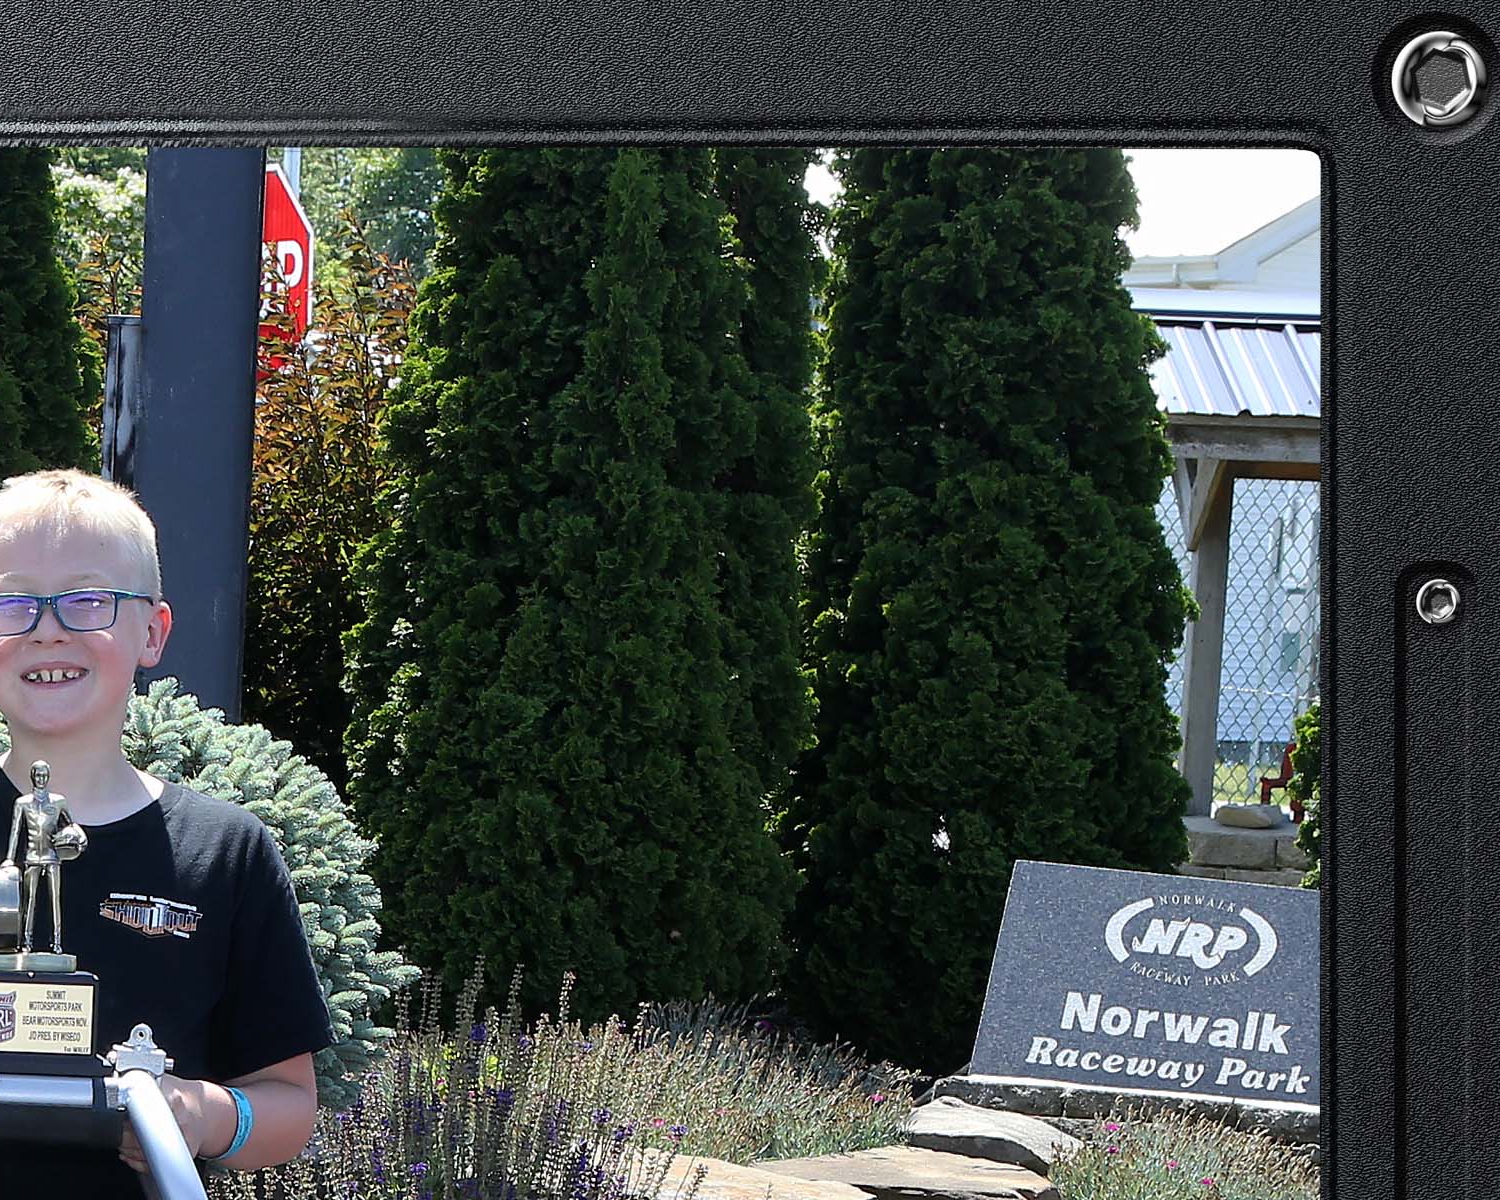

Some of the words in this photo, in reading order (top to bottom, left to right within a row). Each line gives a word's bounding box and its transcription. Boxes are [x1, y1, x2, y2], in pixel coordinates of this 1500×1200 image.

[1158, 895, 1237, 913] NORWALK
[1132, 917, 1248, 969] NRP
[1130, 962, 1191, 987] RACEWAY
[1204, 970, 1240, 987] PARK
[1060, 991, 1292, 1055] Norwalk
[1025, 1036, 1205, 1088] Raceway
[1215, 1056, 1311, 1094] Park
